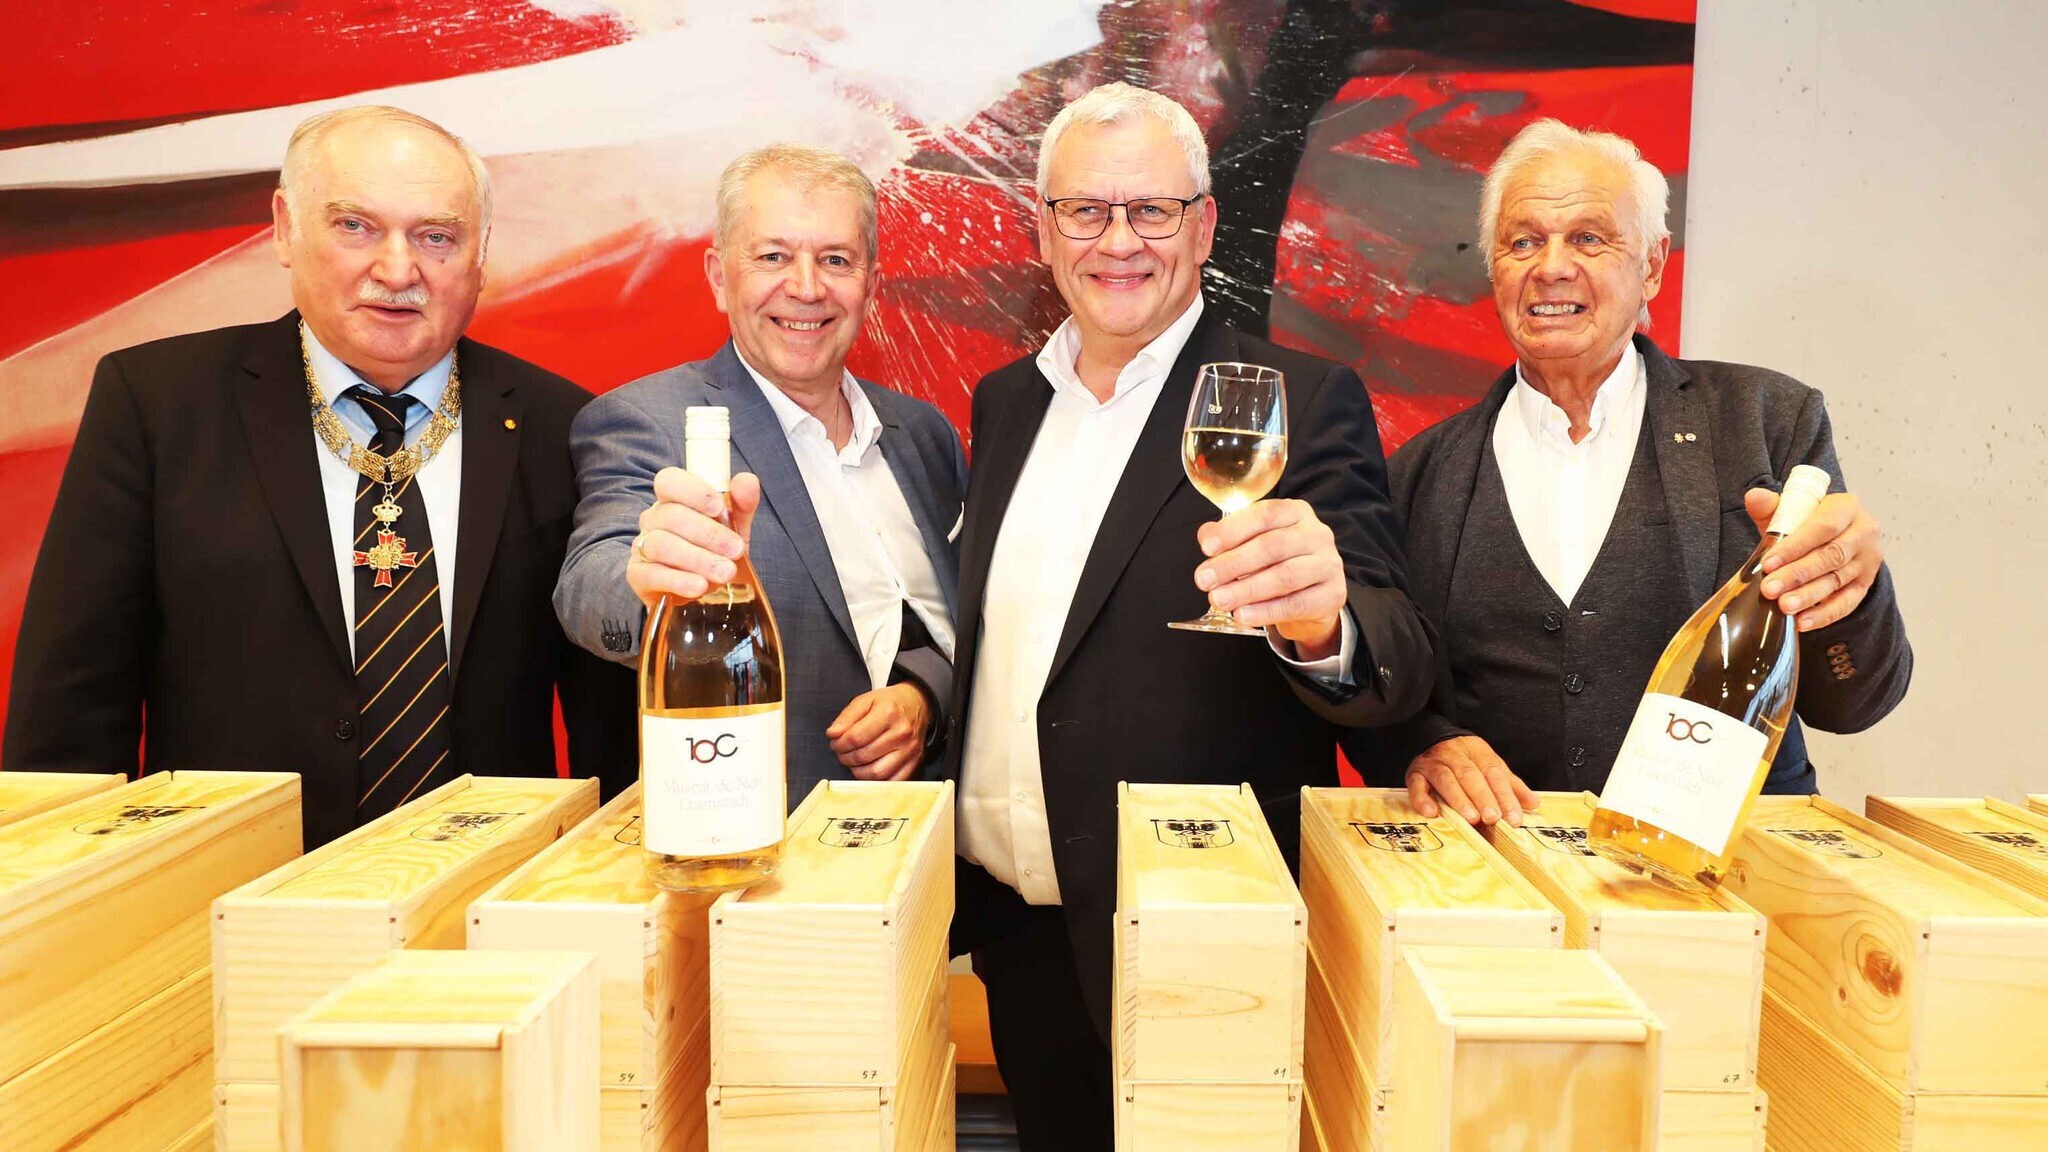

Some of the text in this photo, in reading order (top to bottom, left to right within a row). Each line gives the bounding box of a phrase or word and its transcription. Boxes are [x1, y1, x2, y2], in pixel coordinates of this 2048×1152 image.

[715, 777, 732, 793] de
[862, 1070, 877, 1079] 57
[1722, 1074, 1740, 1084] 67
